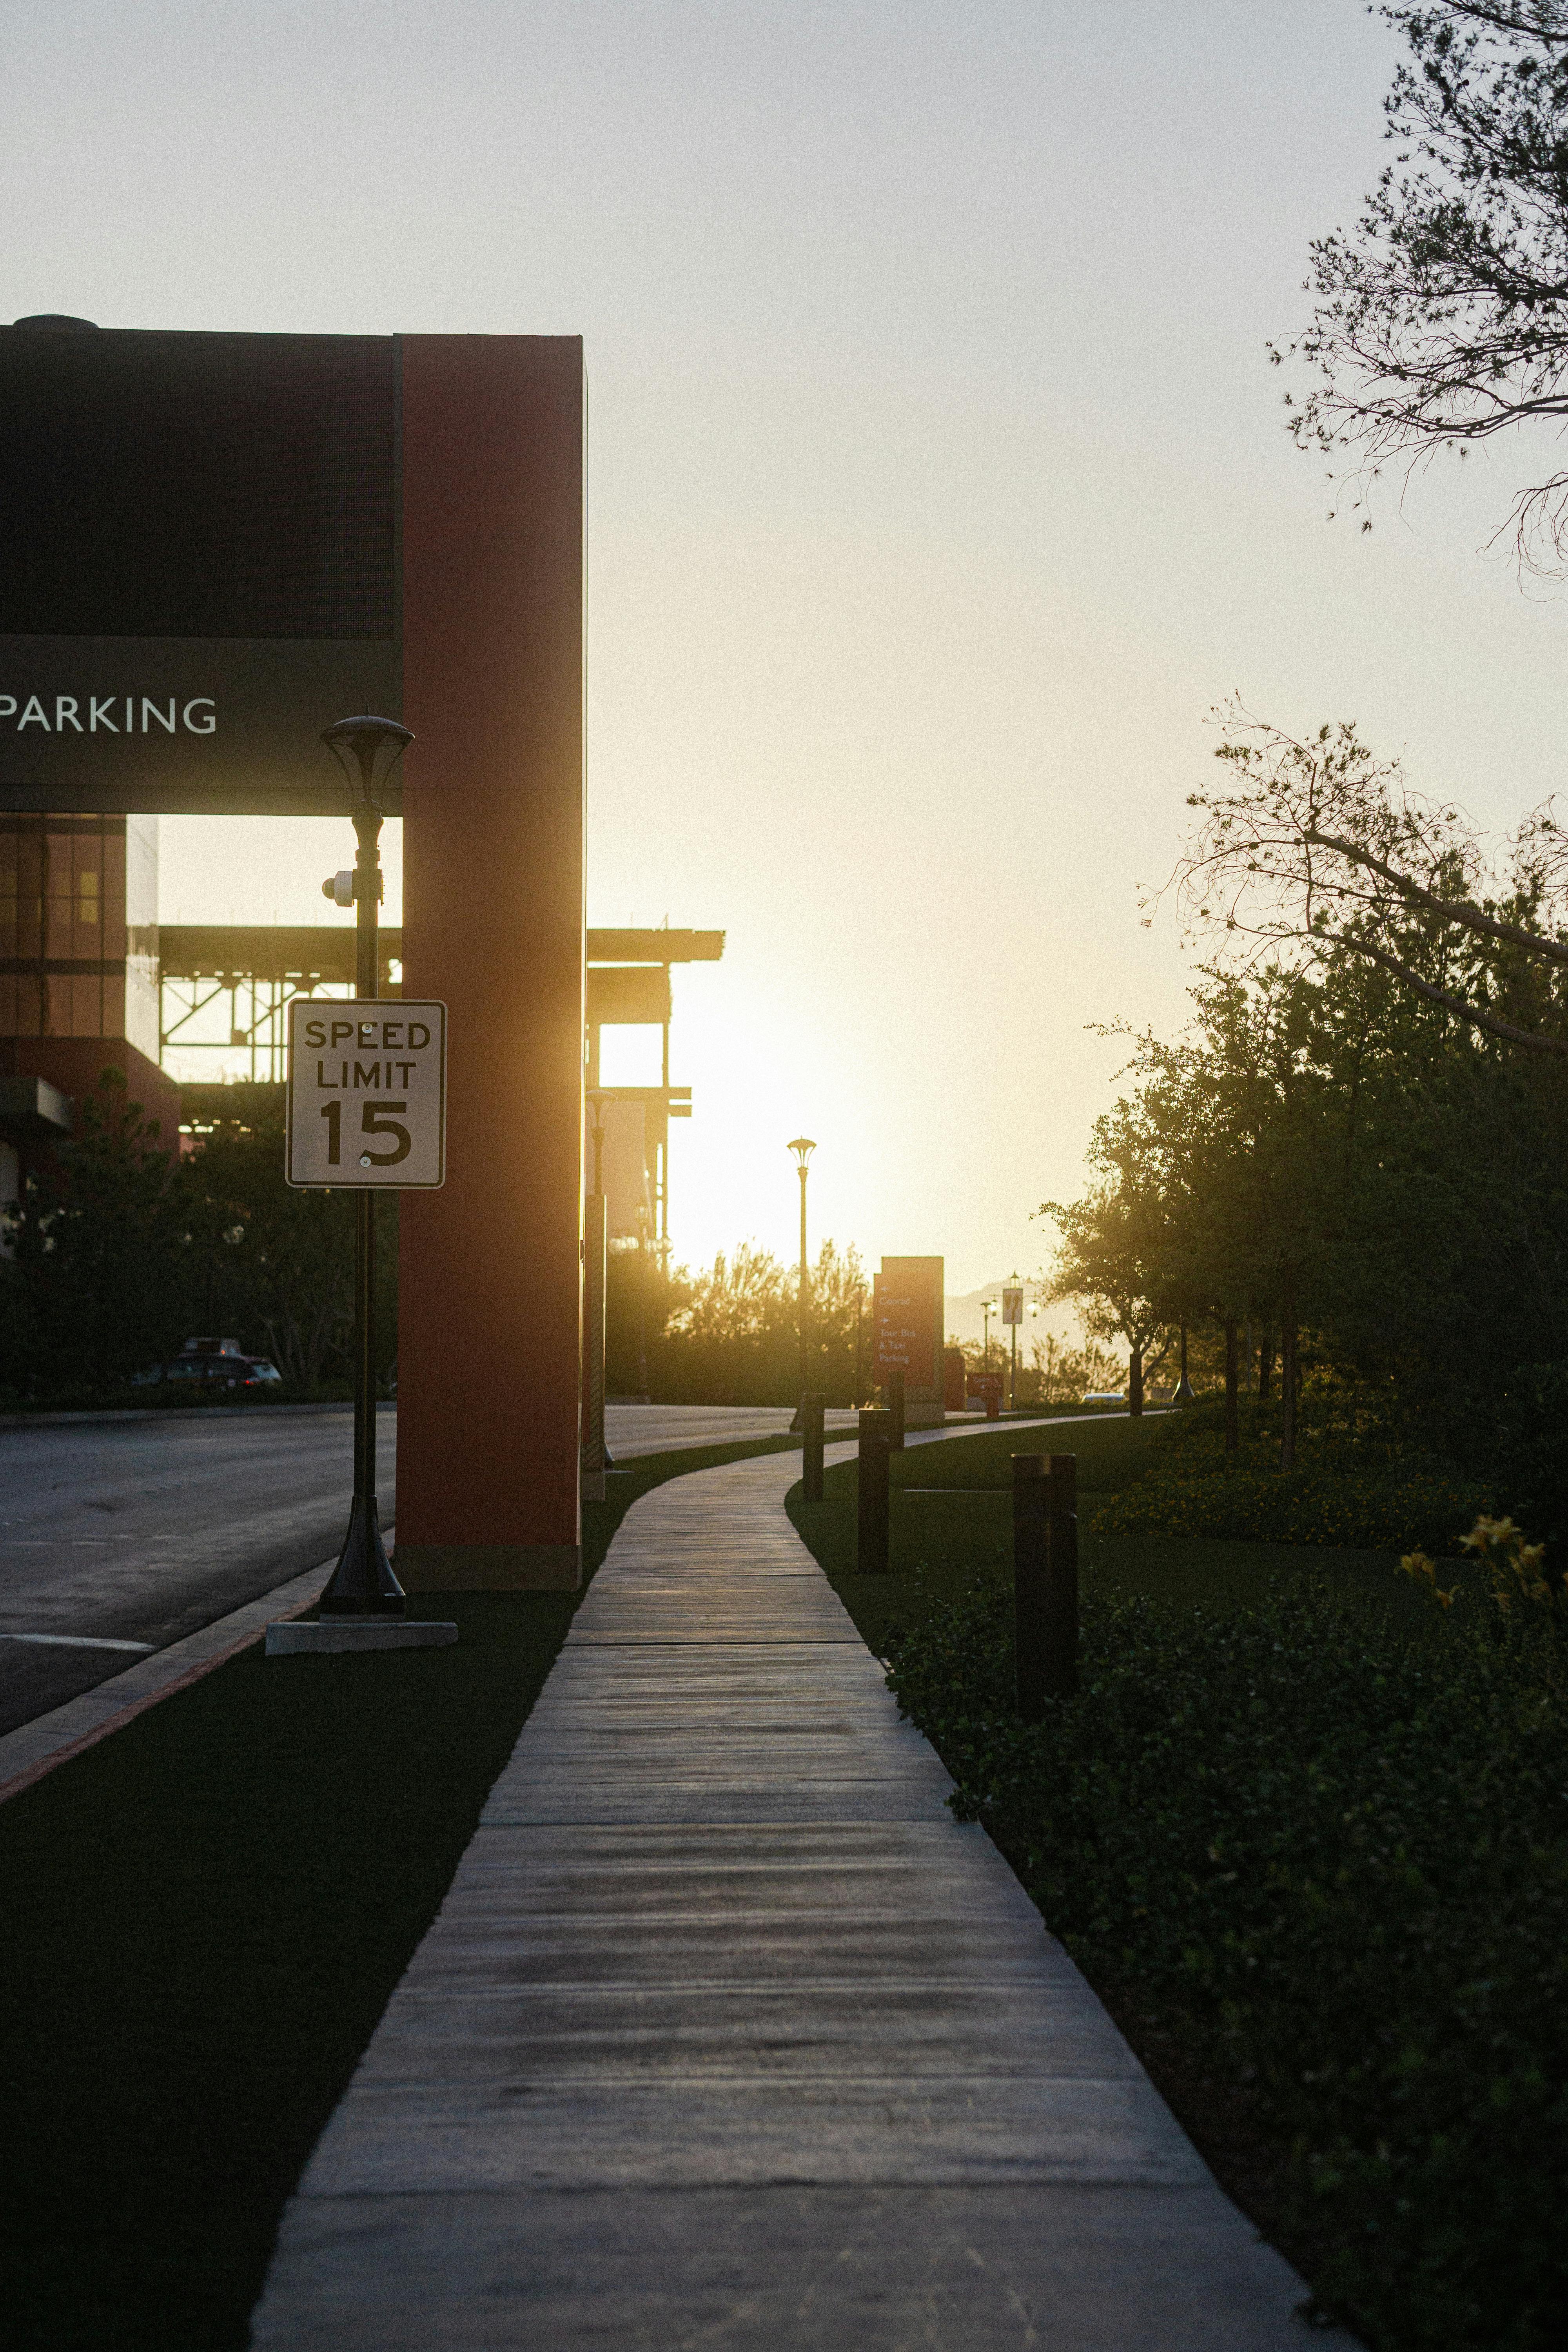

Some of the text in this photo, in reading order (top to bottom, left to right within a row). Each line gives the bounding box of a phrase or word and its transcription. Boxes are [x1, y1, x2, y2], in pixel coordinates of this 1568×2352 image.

[0, 695, 216, 734] PARKING
[304, 1021, 431, 1050] SPEED
[317, 1061, 416, 1089] LIMIT
[321, 1100, 412, 1167] 15
[879, 1354, 910, 1364] Parking
